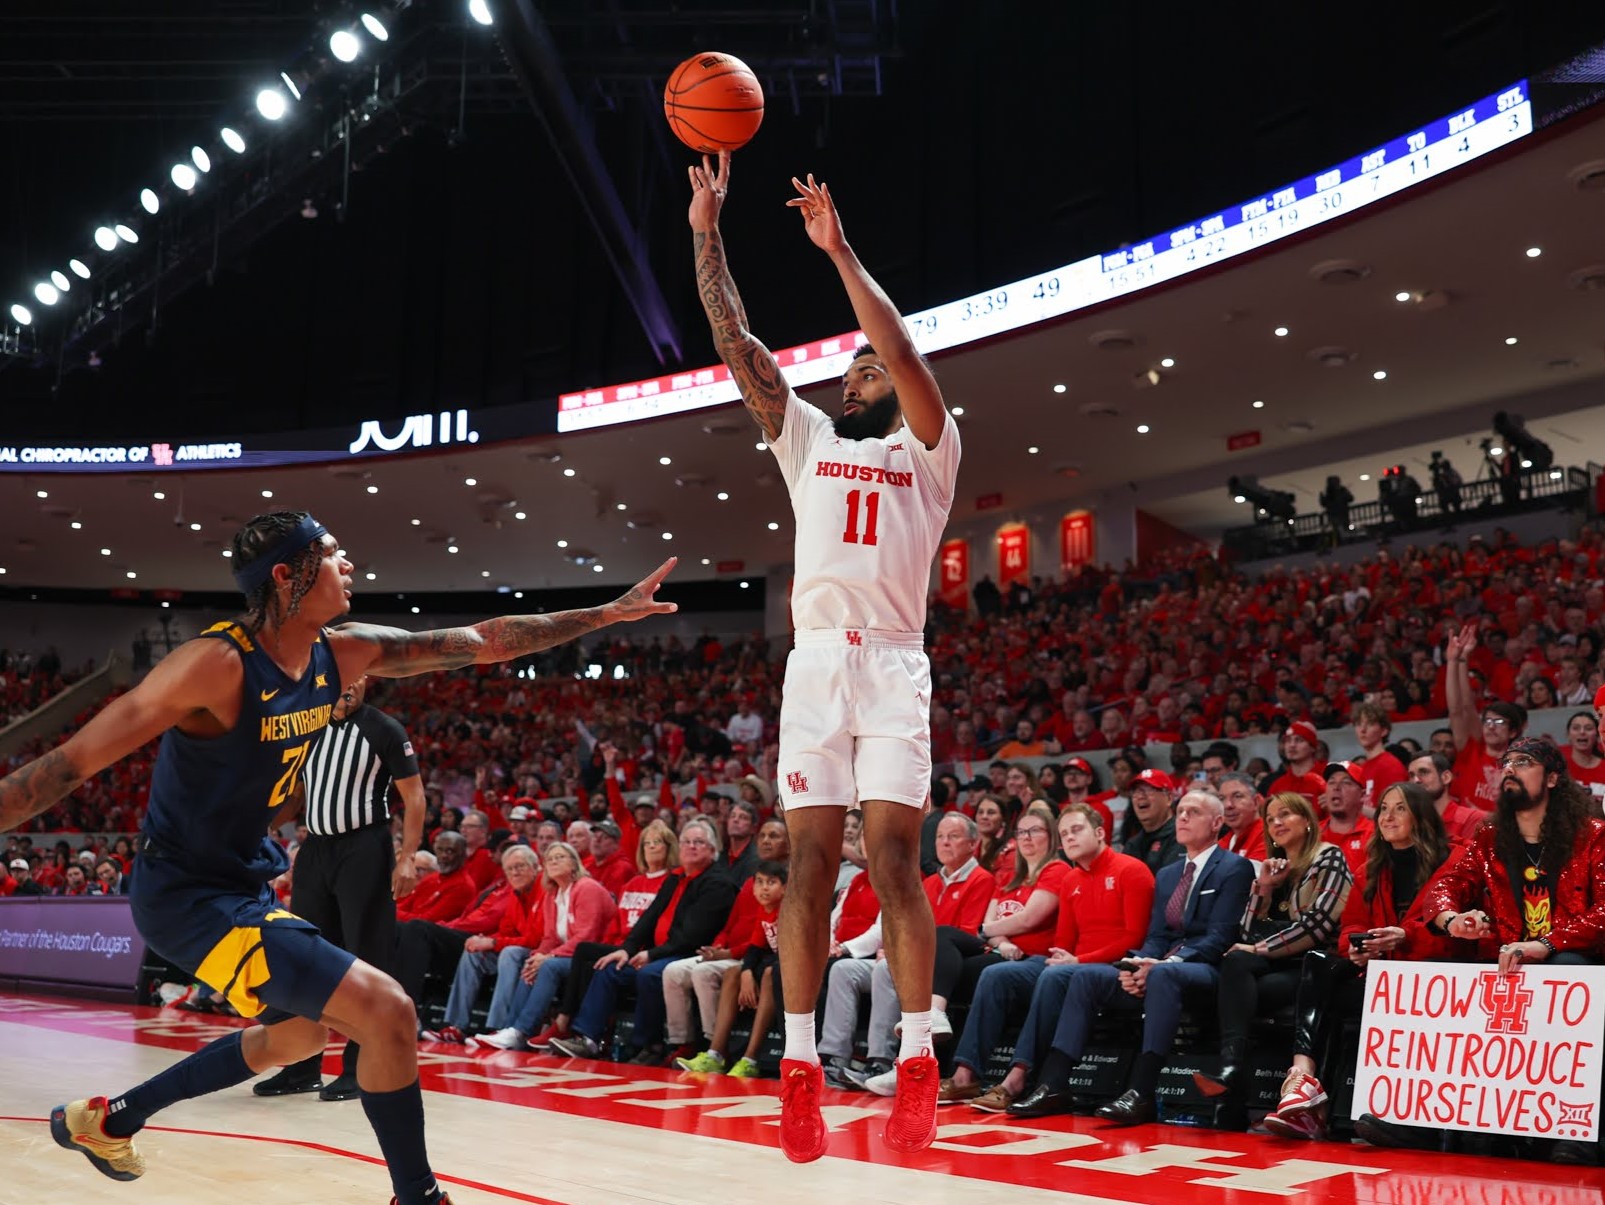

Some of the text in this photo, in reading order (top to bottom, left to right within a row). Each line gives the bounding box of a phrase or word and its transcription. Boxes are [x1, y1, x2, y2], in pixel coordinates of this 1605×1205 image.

[1496, 86, 1524, 112] STL
[1205, 237, 1226, 256] 22
[1249, 222, 1267, 241] 15
[1278, 209, 1298, 229] 19
[1319, 192, 1342, 213] 30
[1370, 175, 1380, 191] 7
[1409, 154, 1430, 175] 11
[1458, 137, 1470, 152] 4
[1507, 114, 1519, 132] 3
[913, 278, 1060, 337] 79 3:39 49
[20, 448, 126, 463] CHIROPRACTOR
[128, 447, 149, 462] OF
[176, 443, 242, 461] ATHLETICS
[815, 461, 913, 488] HOUSTON
[843, 489, 880, 546] 11
[846, 631, 862, 646] UH
[260, 714, 291, 742] WEST
[786, 771, 809, 794] UH
[52, 932, 91, 951] Houston
[91, 932, 131, 958] Cougars
[1370, 970, 1590, 1035] ALLOW UH TO
[1364, 1027, 1594, 1088] REINTRODUCE
[1368, 1074, 1556, 1133] OURSELVES
